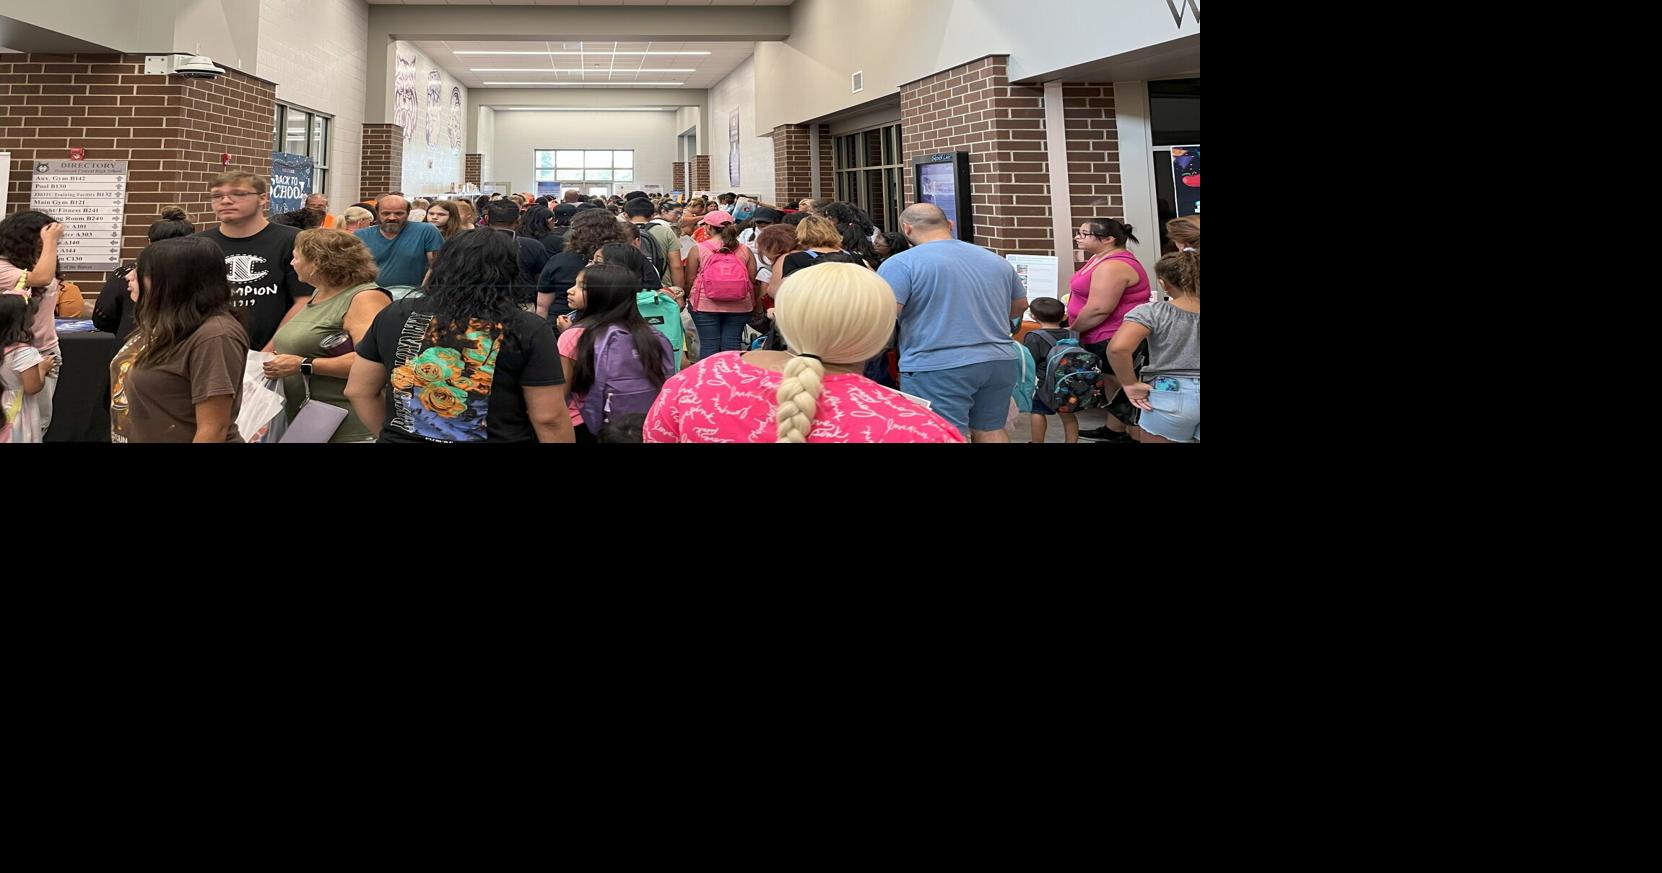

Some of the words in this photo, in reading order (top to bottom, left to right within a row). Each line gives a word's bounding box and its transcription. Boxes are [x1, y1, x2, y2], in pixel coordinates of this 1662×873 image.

[275, 174, 290, 186] BACK
[291, 176, 298, 187] TO
[230, 283, 278, 296] MPION
